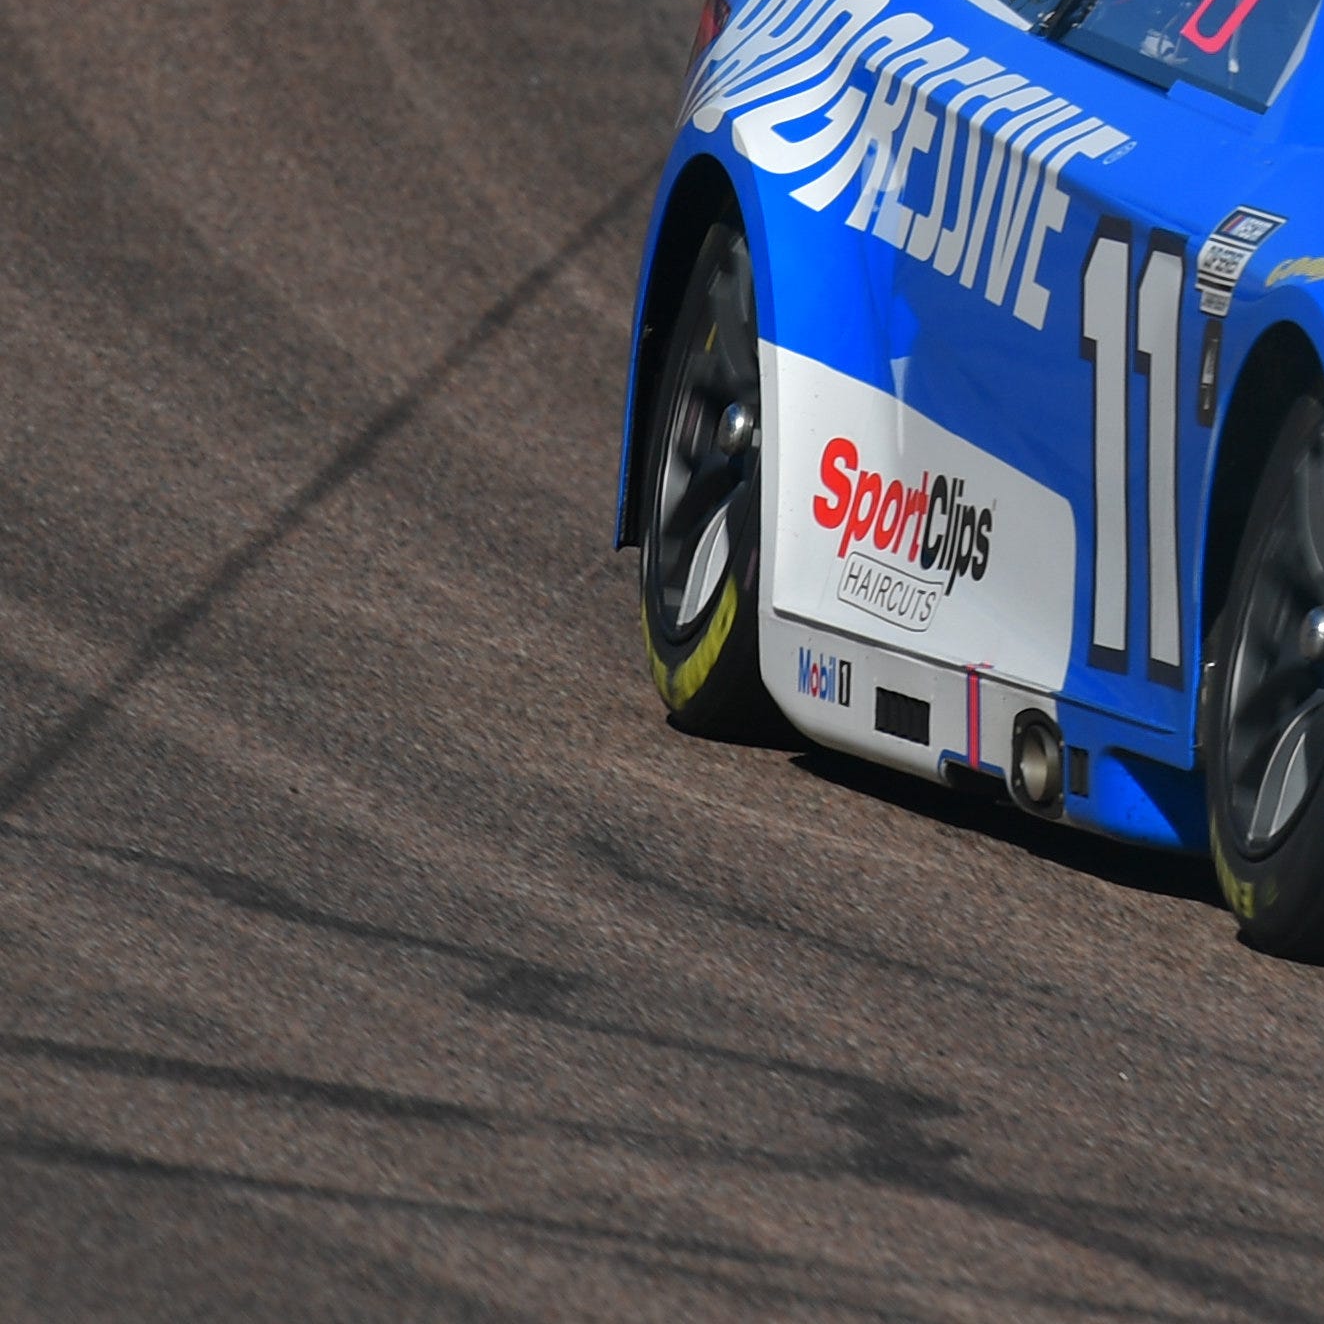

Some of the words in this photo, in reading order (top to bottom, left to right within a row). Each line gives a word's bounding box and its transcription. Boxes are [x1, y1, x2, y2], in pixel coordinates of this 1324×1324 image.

[1079, 213, 1188, 691] 11
[842, 561, 937, 622] HAIRCUTS
[797, 646, 836, 704] Mobil
[840, 661, 850, 706] 1
